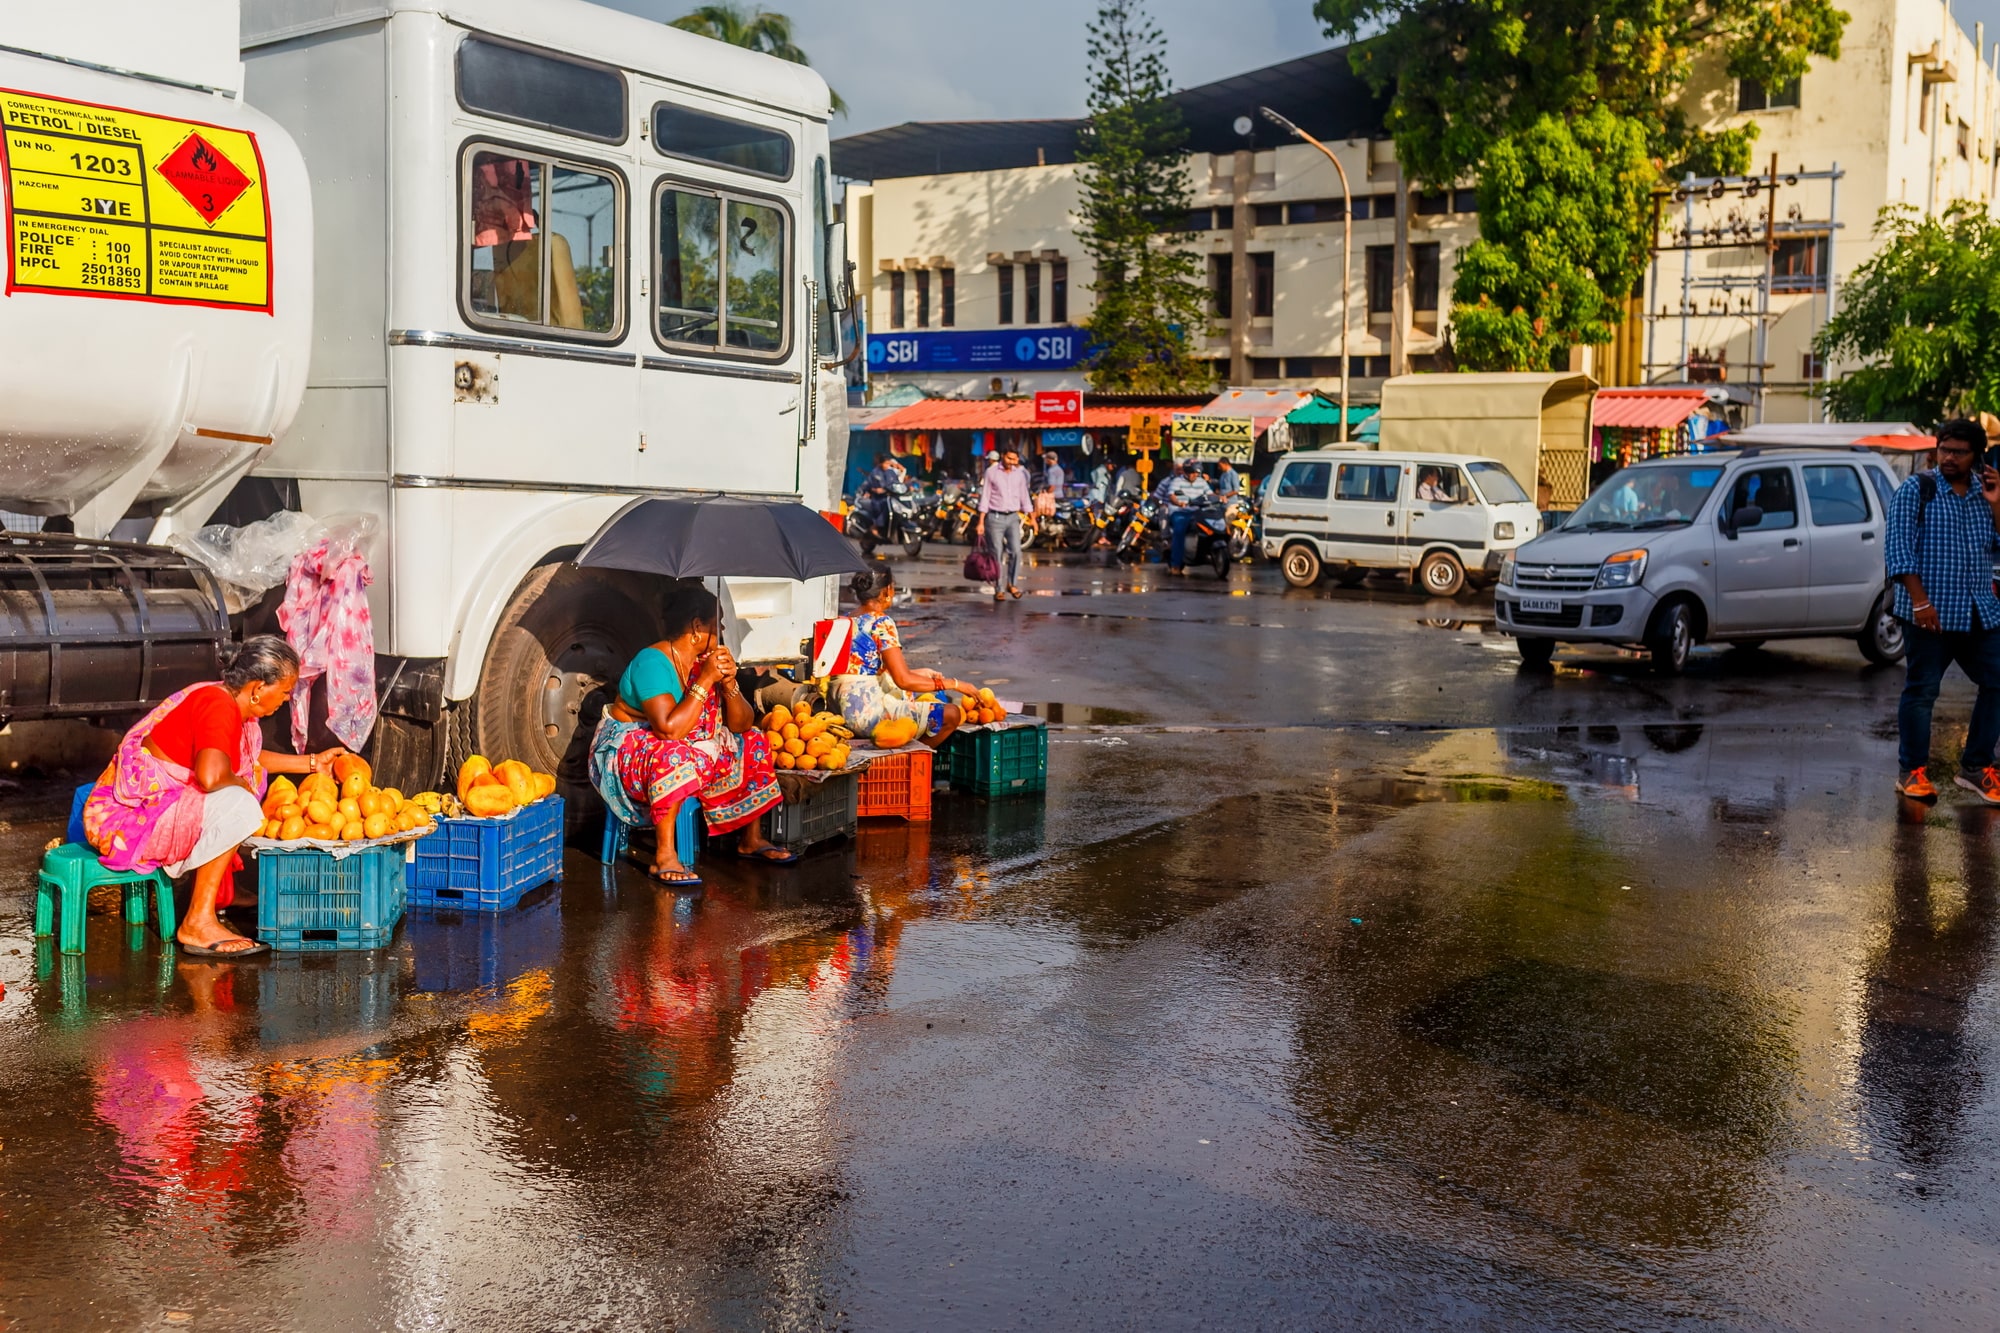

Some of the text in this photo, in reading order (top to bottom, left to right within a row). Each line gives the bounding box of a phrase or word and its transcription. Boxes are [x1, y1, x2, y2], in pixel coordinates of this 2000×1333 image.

[8, 101, 116, 123] CORRECT TECHNICAL NAME
[9, 111, 73, 130] PETROL
[87, 123, 141, 140] DIESEL
[14, 140, 55, 152] UN NO.
[70, 153, 131, 176] 1203
[19, 180, 59, 190] HAZCHEM
[165, 170, 244, 187] FLAMMABLE LIQUID
[202, 194, 214, 212] 3
[32, 222, 86, 233] EMERGENCY
[90, 227, 109, 235] DIAL
[20, 231, 74, 246] POLICE
[106, 242, 131, 253] 100
[159, 241, 232, 254] SPECIALIST ADVICE:
[20, 243, 54, 255] FIRE
[106, 254, 130, 264] 101
[183, 253, 215, 261] CONTACT
[20, 256, 141, 277] HPCL 2501360
[172, 261, 200, 269] VAPOUR
[159, 269, 197, 278] EVACUATE
[82, 274, 140, 288] 2518853
[159, 278, 229, 290] CONTAIN SPILLAGE
[886, 340, 918, 363] SBI
[1037, 336, 1072, 360] SBI
[1143, 416, 1151, 428] P
[1176, 422, 1250, 435] XEROX
[1178, 442, 1249, 455] XEROX
